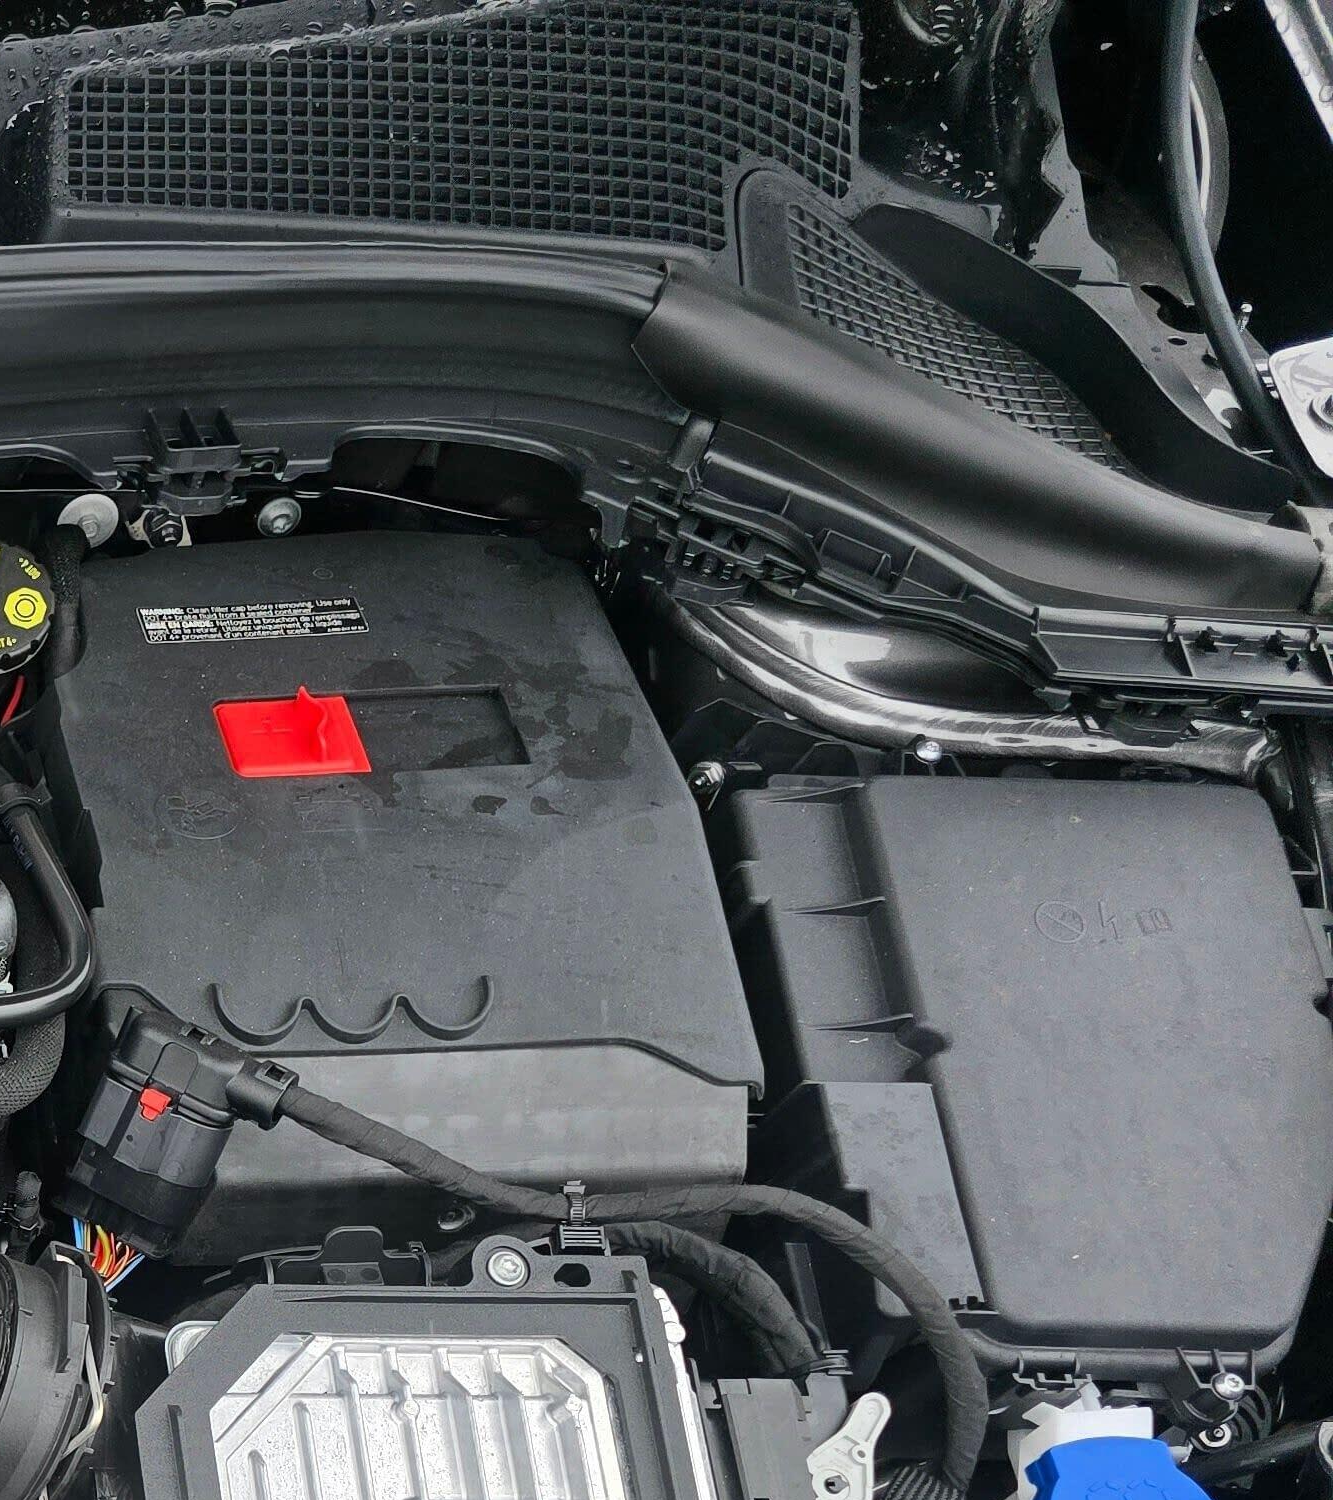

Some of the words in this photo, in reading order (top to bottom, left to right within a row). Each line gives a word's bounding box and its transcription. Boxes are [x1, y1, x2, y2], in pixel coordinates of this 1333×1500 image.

[247, 603, 273, 611] before
[216, 619, 253, 627] Nettoyez
[262, 616, 298, 624] bouchon
[253, 622, 301, 630] uniquement
